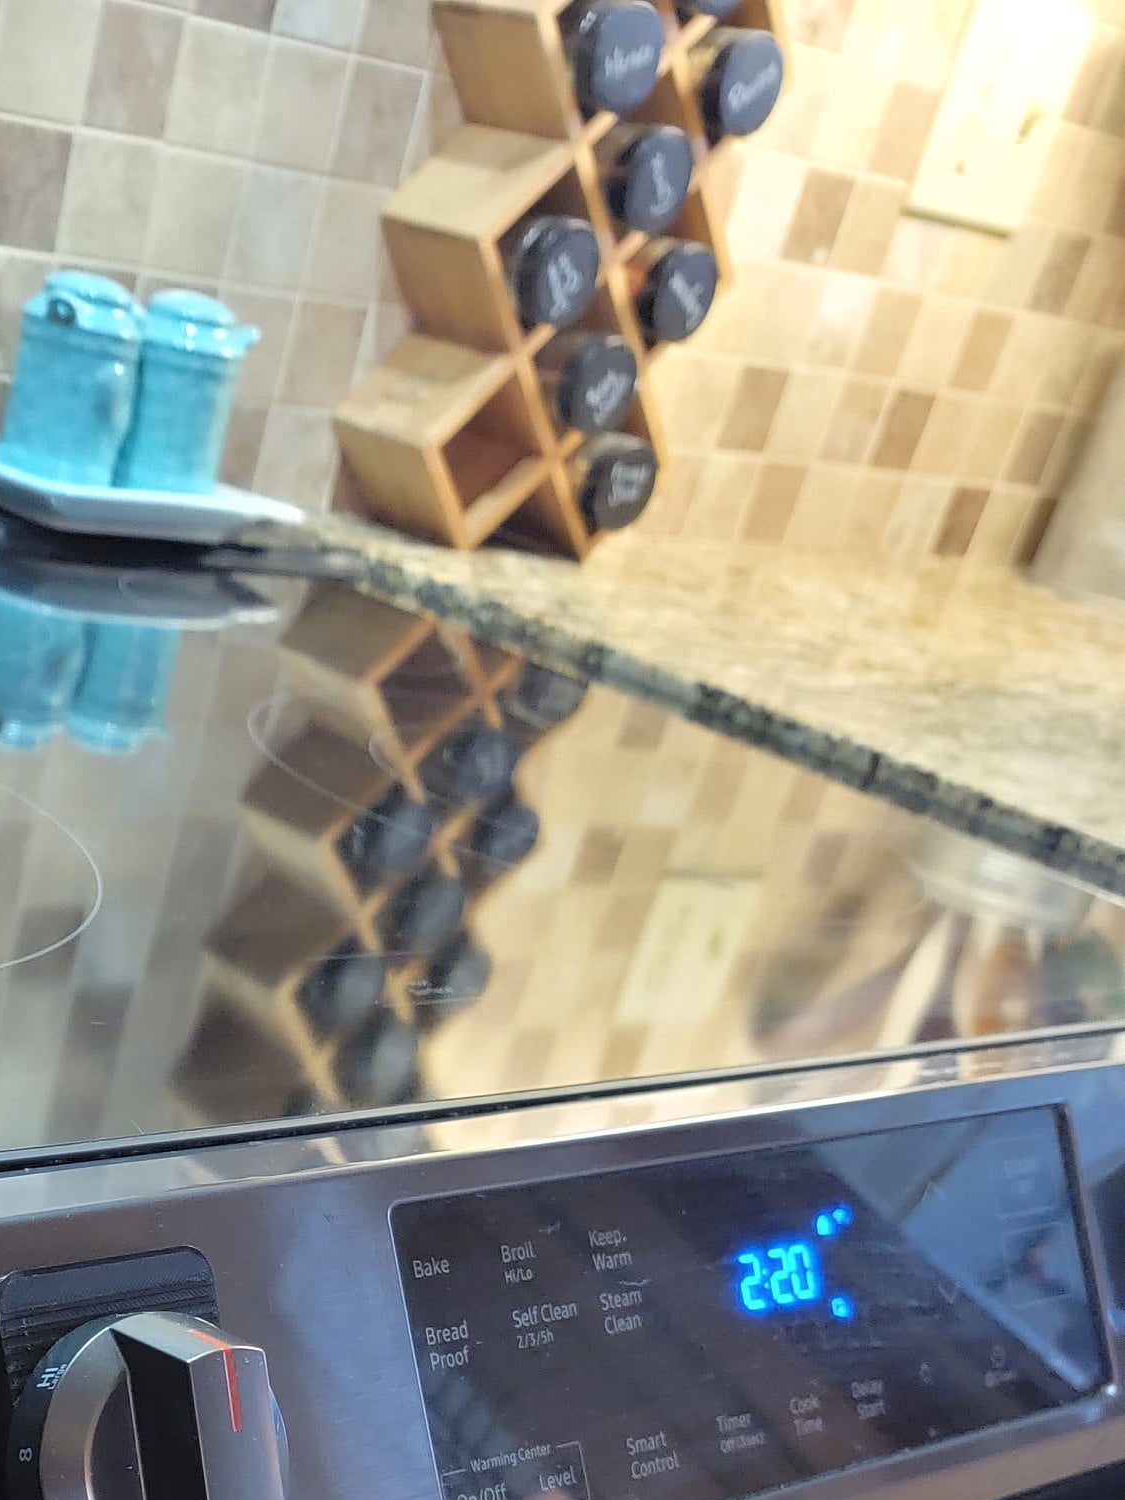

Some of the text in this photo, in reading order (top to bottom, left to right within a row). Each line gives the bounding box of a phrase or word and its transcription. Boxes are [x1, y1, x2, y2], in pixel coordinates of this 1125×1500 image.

[500, 1240, 536, 1264] Broil
[592, 1251, 633, 1272] Warm
[412, 1256, 451, 1279] Bake
[738, 1244, 816, 1310] 2:20
[599, 1289, 643, 1312] Steam
[512, 1301, 578, 1329] Self Clean
[603, 1313, 643, 1336] Clean
[425, 1320, 469, 1346] Bread
[429, 1346, 471, 1371] Proof
[626, 1431, 667, 1455] Smart
[469, 1443, 553, 1473] Warming Center
[631, 1451, 681, 1480] Control
[539, 1466, 577, 1492] Level
